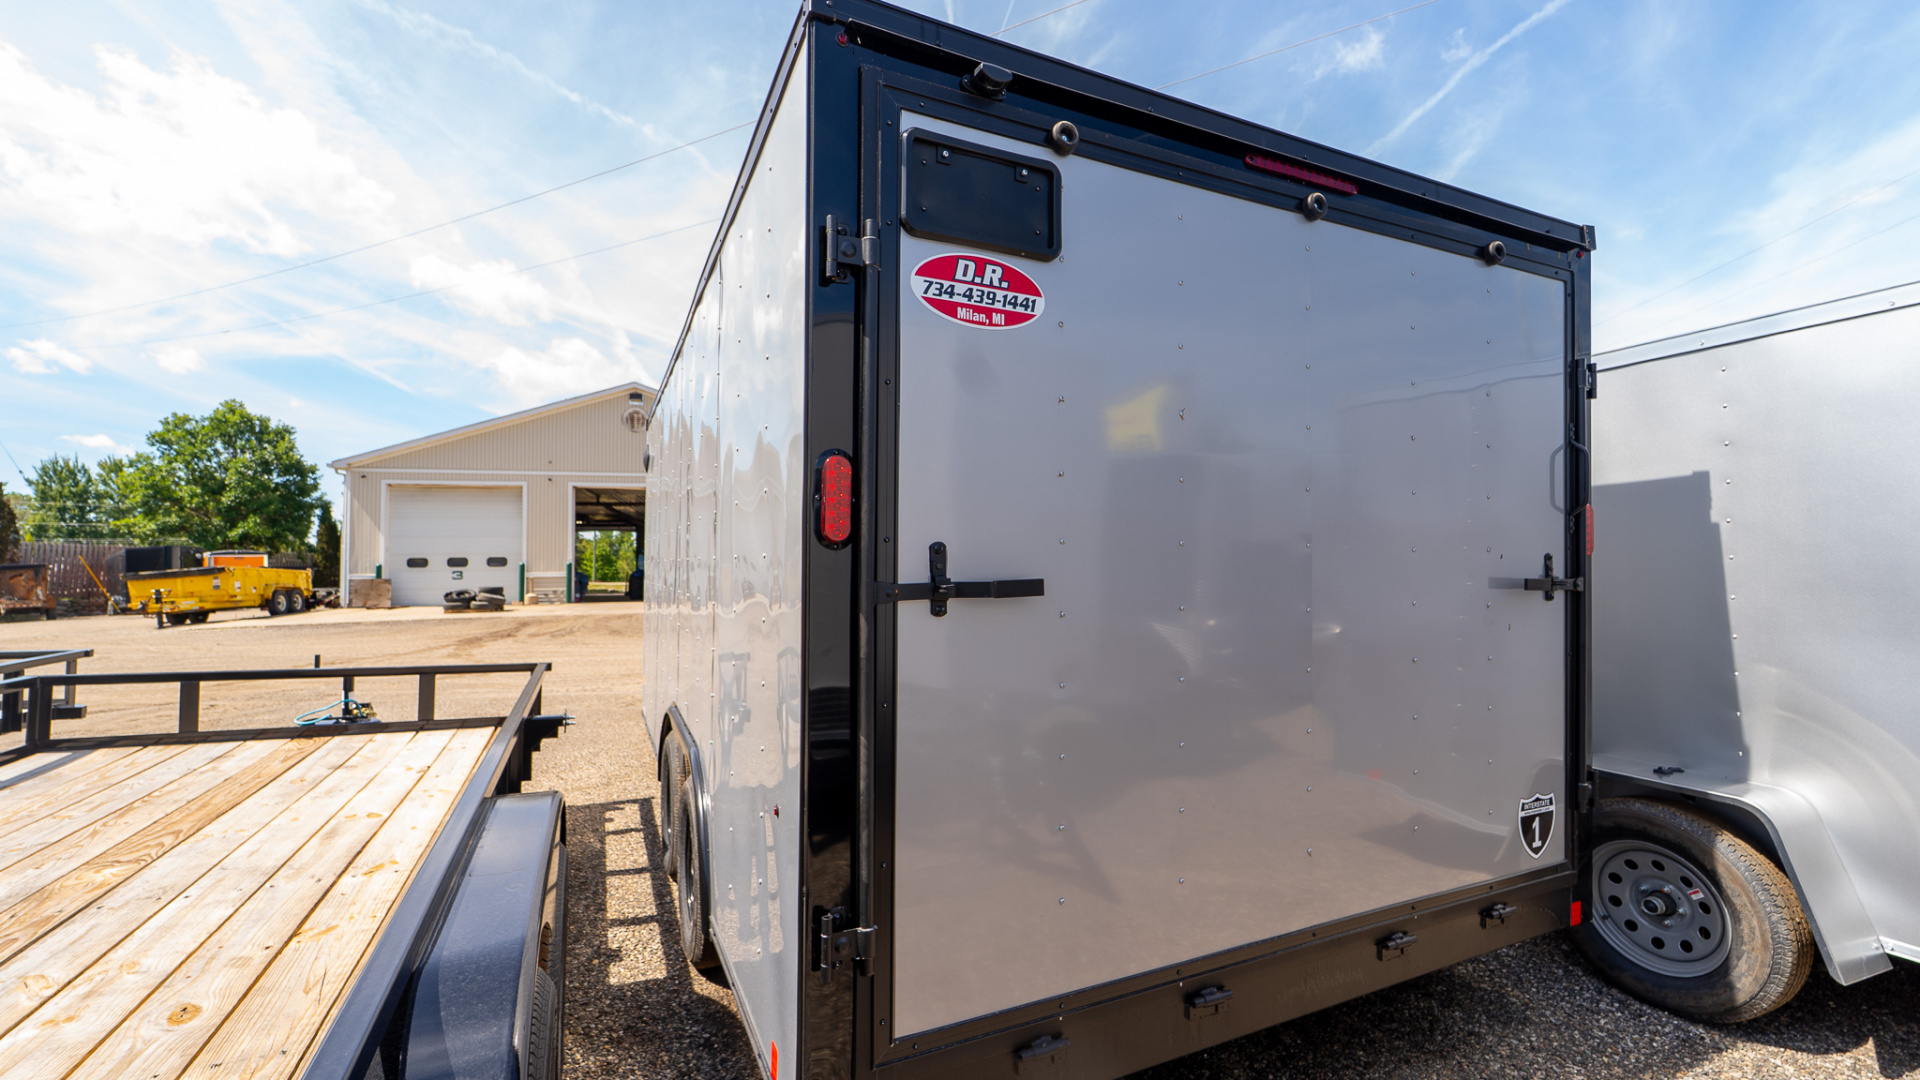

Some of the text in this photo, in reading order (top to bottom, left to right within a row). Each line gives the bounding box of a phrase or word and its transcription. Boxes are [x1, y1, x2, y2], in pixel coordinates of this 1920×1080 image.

[953, 257, 1010, 290] D.R.
[922, 280, 1037, 313] 734-439-1441
[957, 306, 1005, 326] Milan, MI
[451, 570, 464, 580] 3
[1523, 799, 1550, 810] INTERSTATE
[1532, 816, 1542, 848] 1
